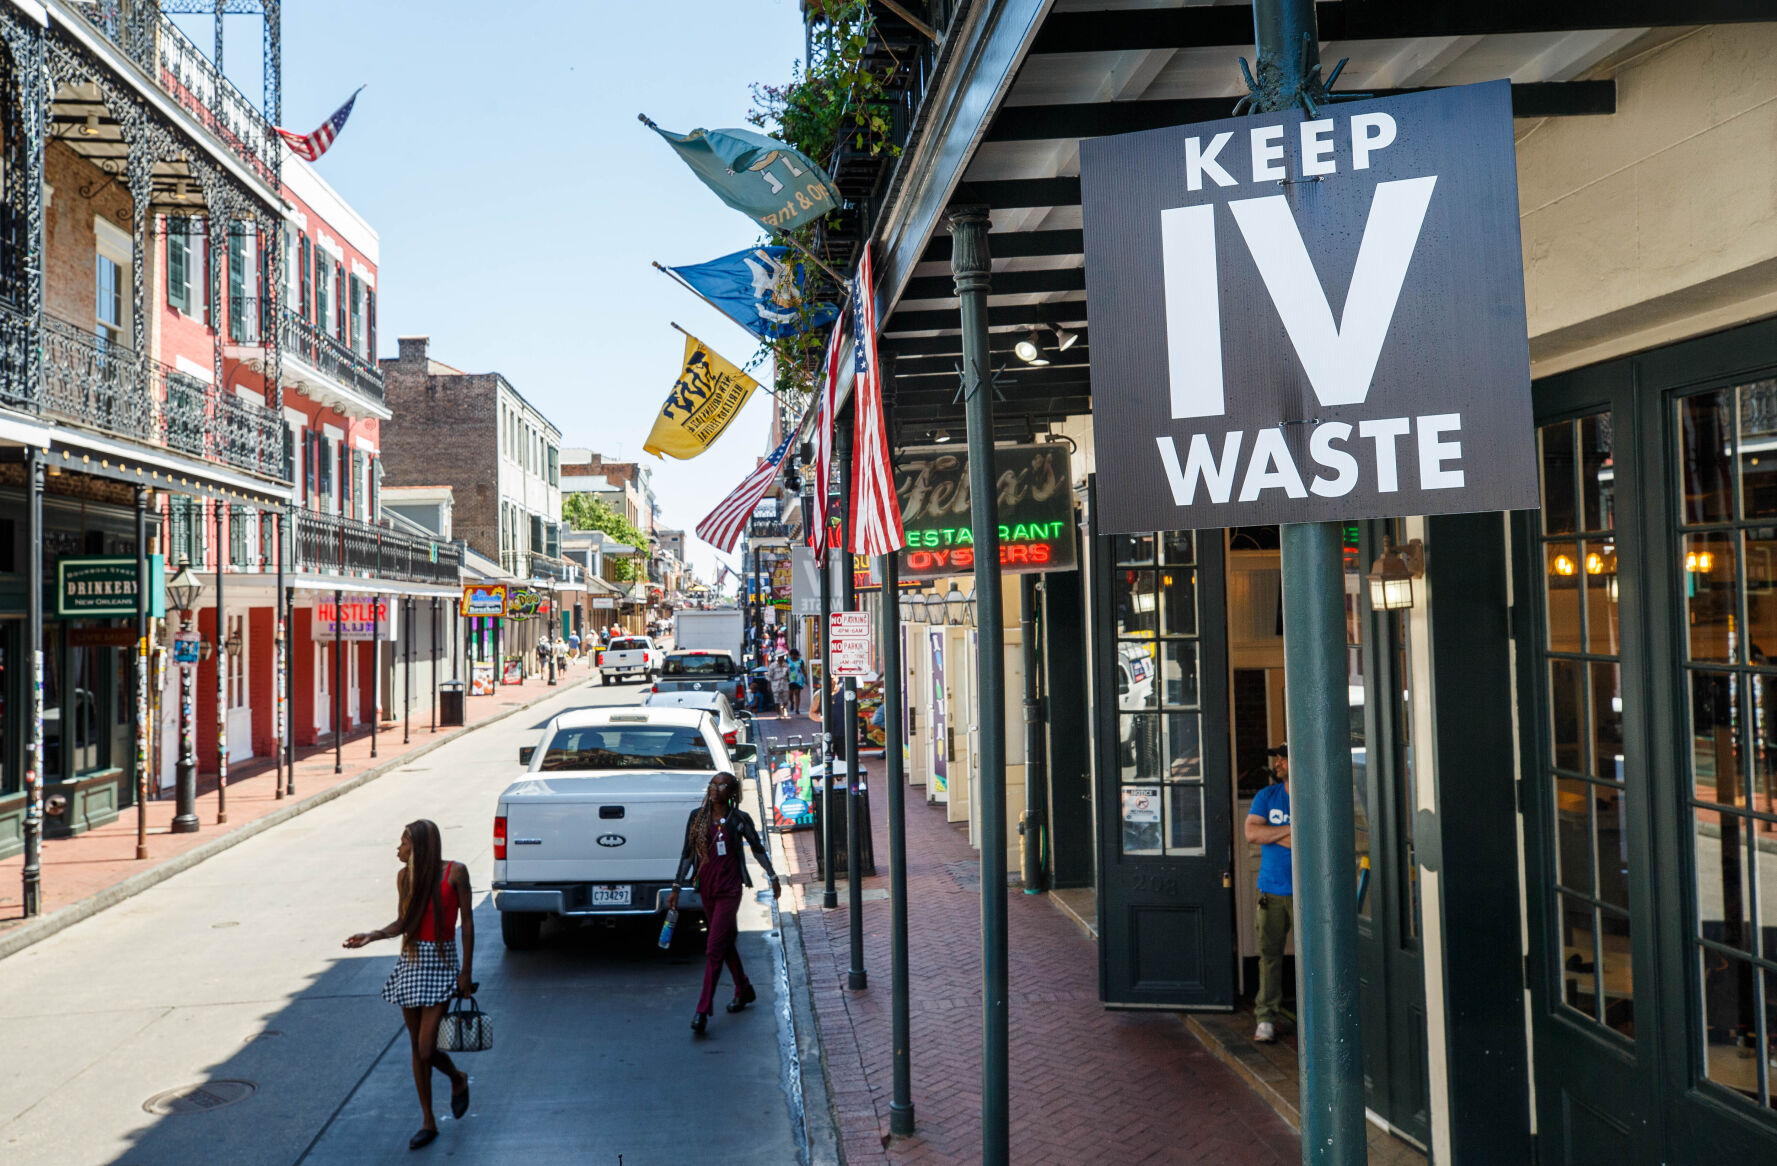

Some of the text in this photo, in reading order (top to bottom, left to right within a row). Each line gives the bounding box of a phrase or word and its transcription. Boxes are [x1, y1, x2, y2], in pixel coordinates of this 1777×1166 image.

[1184, 112, 1397, 191] KEEP
[795, 191, 814, 210] &
[1161, 175, 1438, 419] IV
[1156, 413, 1465, 506] WASTE
[906, 521, 1064, 548] ESTARANT
[906, 543, 1051, 570] OYSERS
[110, 567, 136, 576] STREE
[95, 598, 133, 606] ORLEANS
[318, 603, 386, 622] HUSTLER
[831, 616, 842, 625] NO
[831, 642, 842, 651] NO
